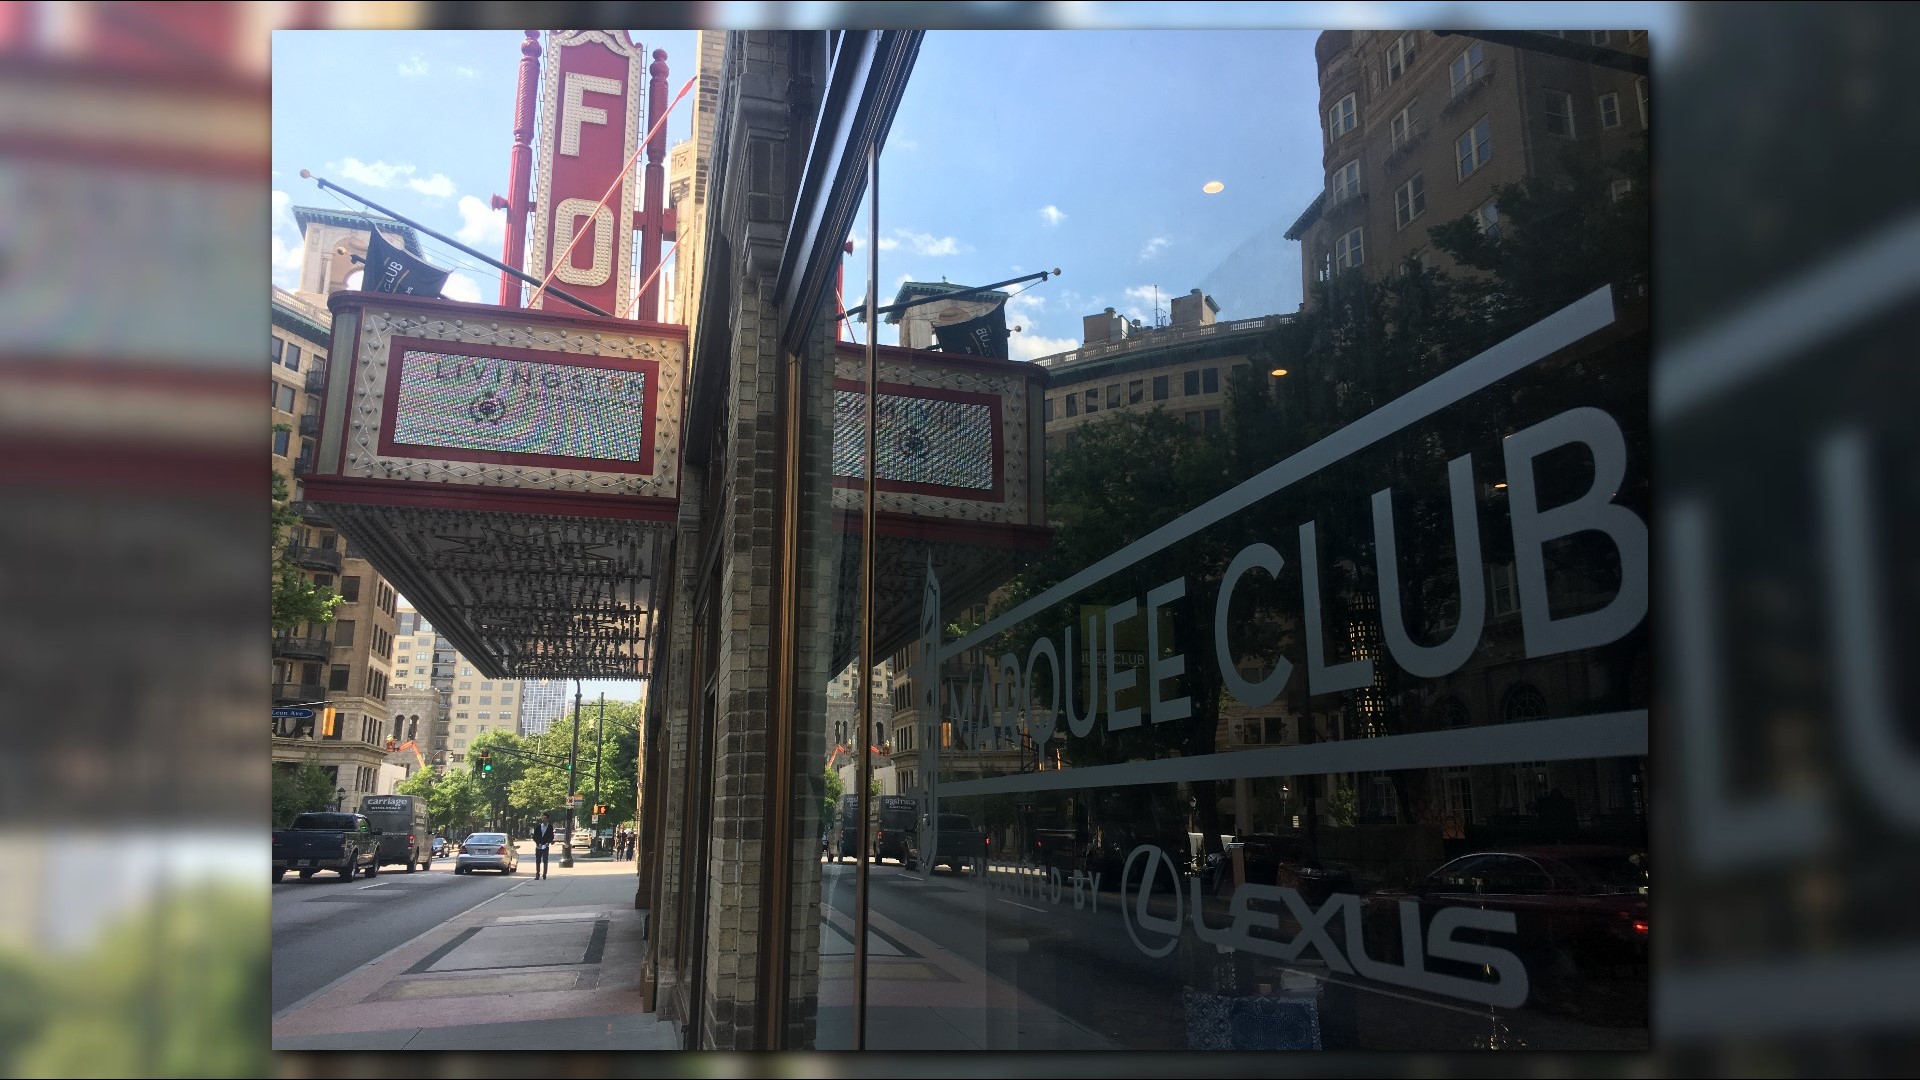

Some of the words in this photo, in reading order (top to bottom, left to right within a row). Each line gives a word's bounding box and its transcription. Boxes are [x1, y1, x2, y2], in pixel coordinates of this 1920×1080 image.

[383, 261, 403, 292] CLUB
[950, 575, 1192, 764] MARQUEE
[1214, 405, 1649, 710] CLUB
[1112, 653, 1145, 665] CLUB
[367, 798, 408, 807] carriage
[1073, 868, 1102, 914] BY
[1190, 877, 1531, 1010] LEXUS
